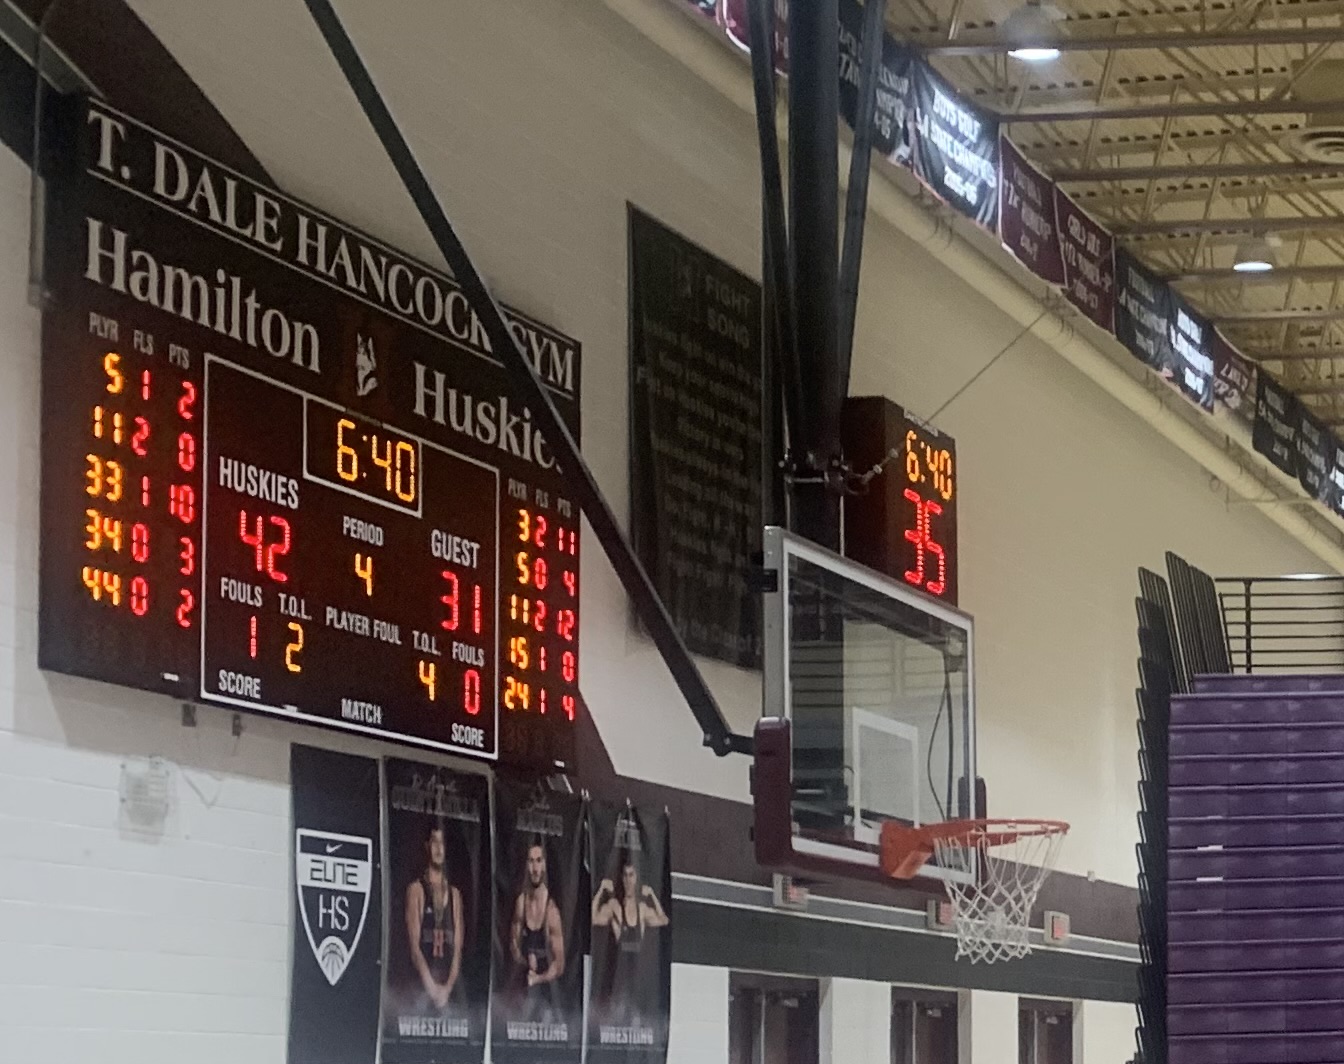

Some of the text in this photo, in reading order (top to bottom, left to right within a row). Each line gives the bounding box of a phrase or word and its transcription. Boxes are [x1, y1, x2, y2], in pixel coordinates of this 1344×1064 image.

[87, 110, 131, 180] T.
[153, 141, 284, 251] DALE
[84, 217, 321, 374] Hamilton
[133, 329, 154, 356] FLS
[169, 343, 190, 370] PTS
[104, 352, 196, 419] 5 1 2
[94, 405, 195, 472] 11 2 0
[414, 362, 563, 475] Huskie
[219, 456, 299, 510] HUSKIES
[337, 419, 416, 503] 6:40
[906, 429, 952, 500] 6:40
[86, 453, 195, 524] 33 1 10
[85, 508, 195, 576] 34 0 3
[239, 509, 291, 583] 42
[343, 515, 384, 547] PERIOD
[431, 529, 480, 569] GUEST
[518, 508, 575, 556] 3 2 11
[903, 487, 946, 596] 35
[82, 566, 195, 628] 44 0 2
[220, 577, 263, 608] FOULS
[354, 552, 373, 597] 4
[517, 551, 575, 597] 5 0 4
[278, 592, 312, 621] T.O.L.
[326, 606, 402, 645] PLAYER FOUL
[440, 570, 482, 635] 31
[510, 593, 575, 641] 11 2 12
[250, 615, 258, 659] 1
[285, 621, 304, 673] 2
[412, 630, 442, 656] T.O.L.
[452, 641, 485, 667] FOULS
[510, 636, 575, 682] 15 1 0
[218, 669, 262, 699] SCORE
[418, 659, 436, 701] 4
[464, 669, 481, 716] 0
[504, 675, 575, 721] 24 1 4
[341, 698, 383, 724] MATCH
[451, 723, 485, 748] SCORE
[319, 893, 350, 932] HS
[398, 1014, 468, 1039] WRESTLING
